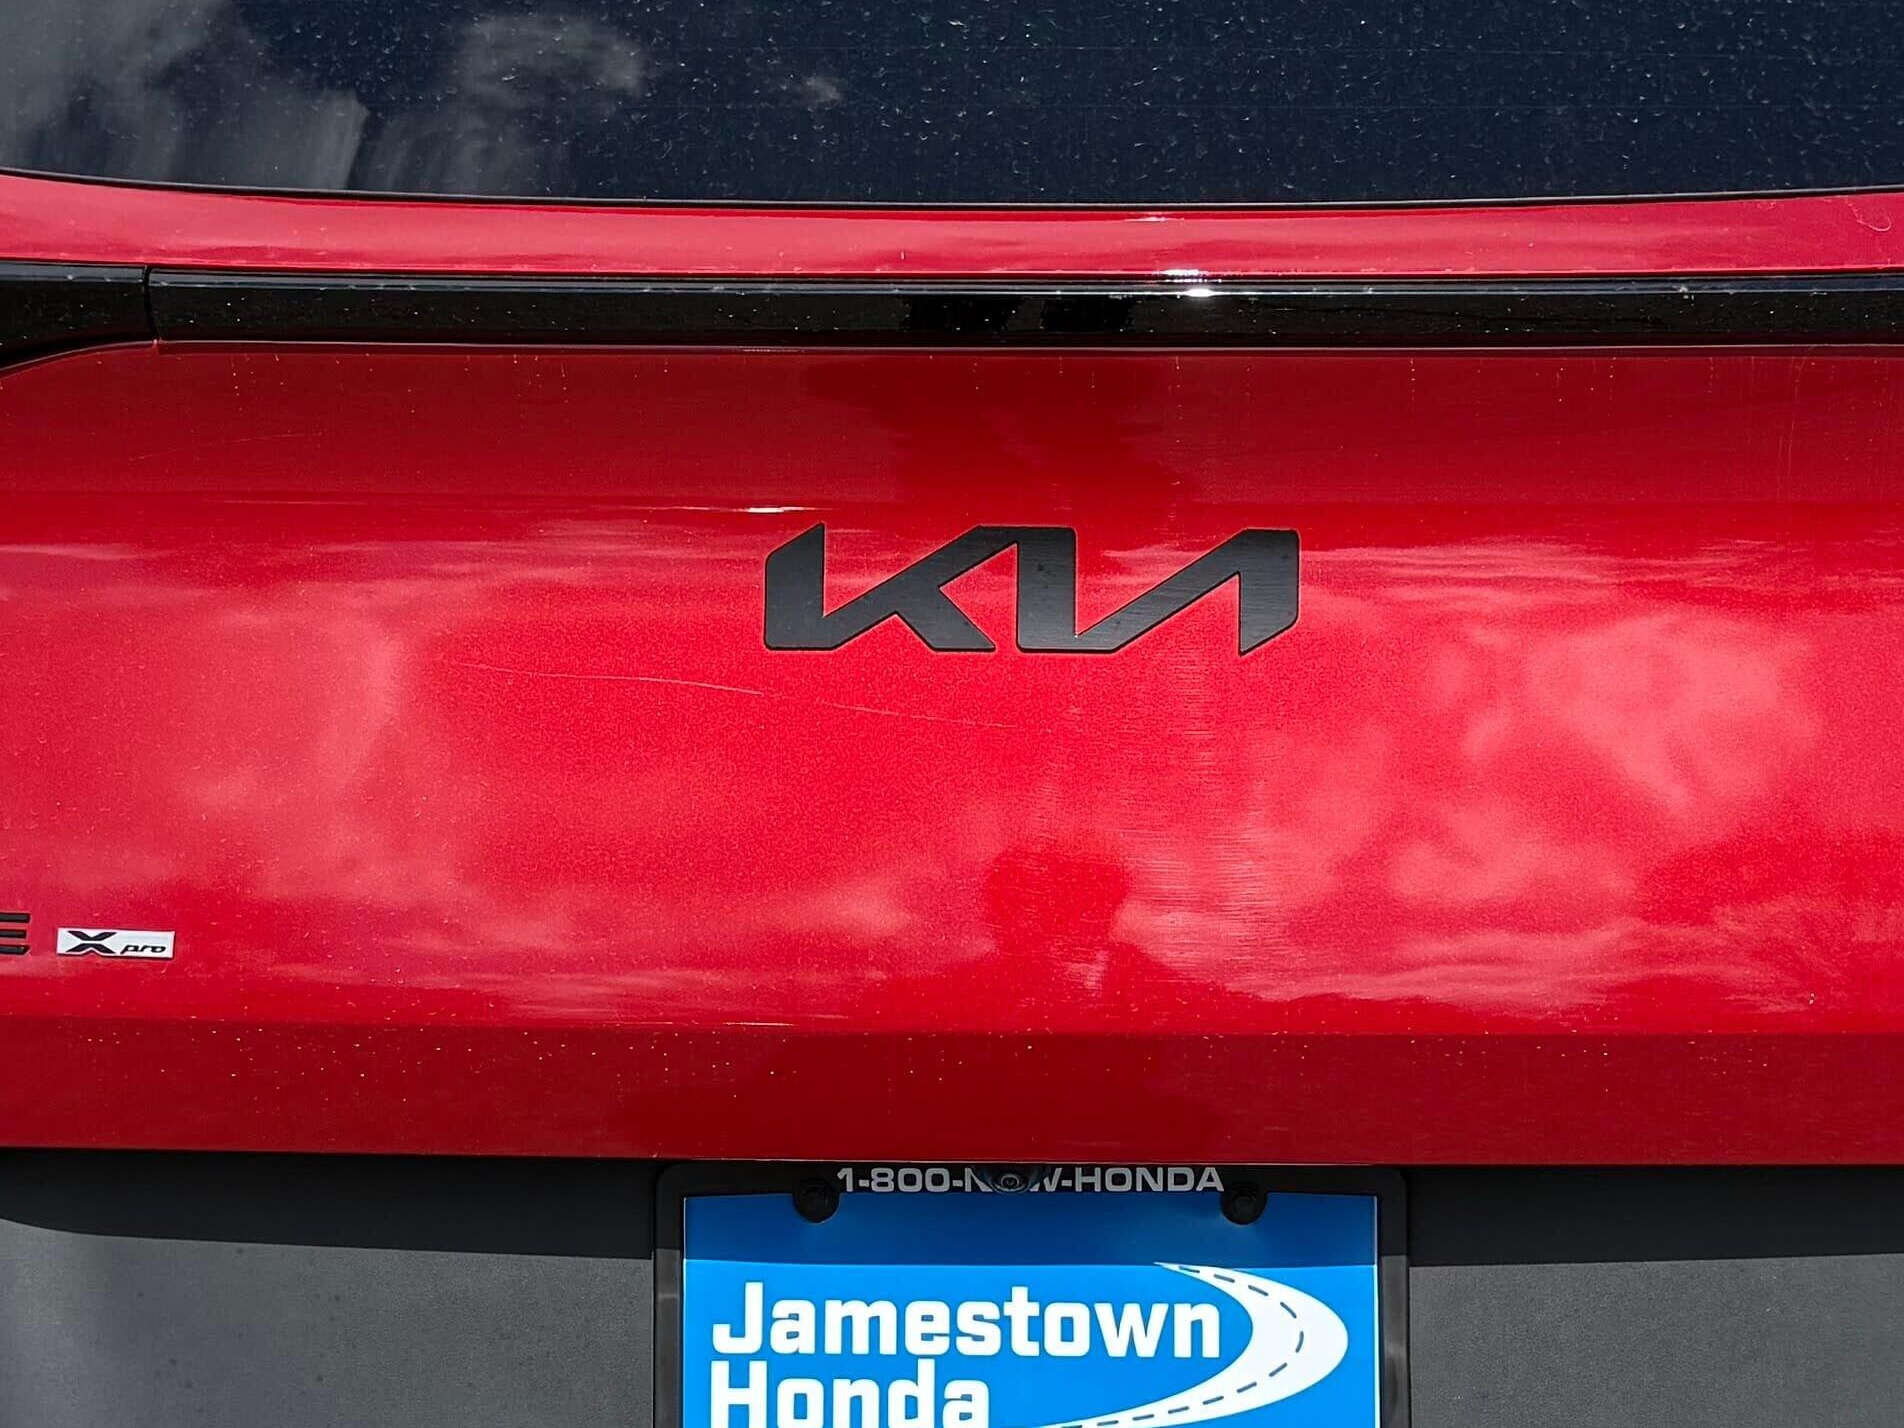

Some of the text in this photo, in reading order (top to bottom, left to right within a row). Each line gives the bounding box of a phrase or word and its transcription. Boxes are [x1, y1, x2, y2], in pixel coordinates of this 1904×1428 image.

[763, 523, 1300, 657] KIA
[837, 1166, 1225, 1193] 1-800-NW-HONDA
[711, 1281, 1221, 1359] Jamestown
